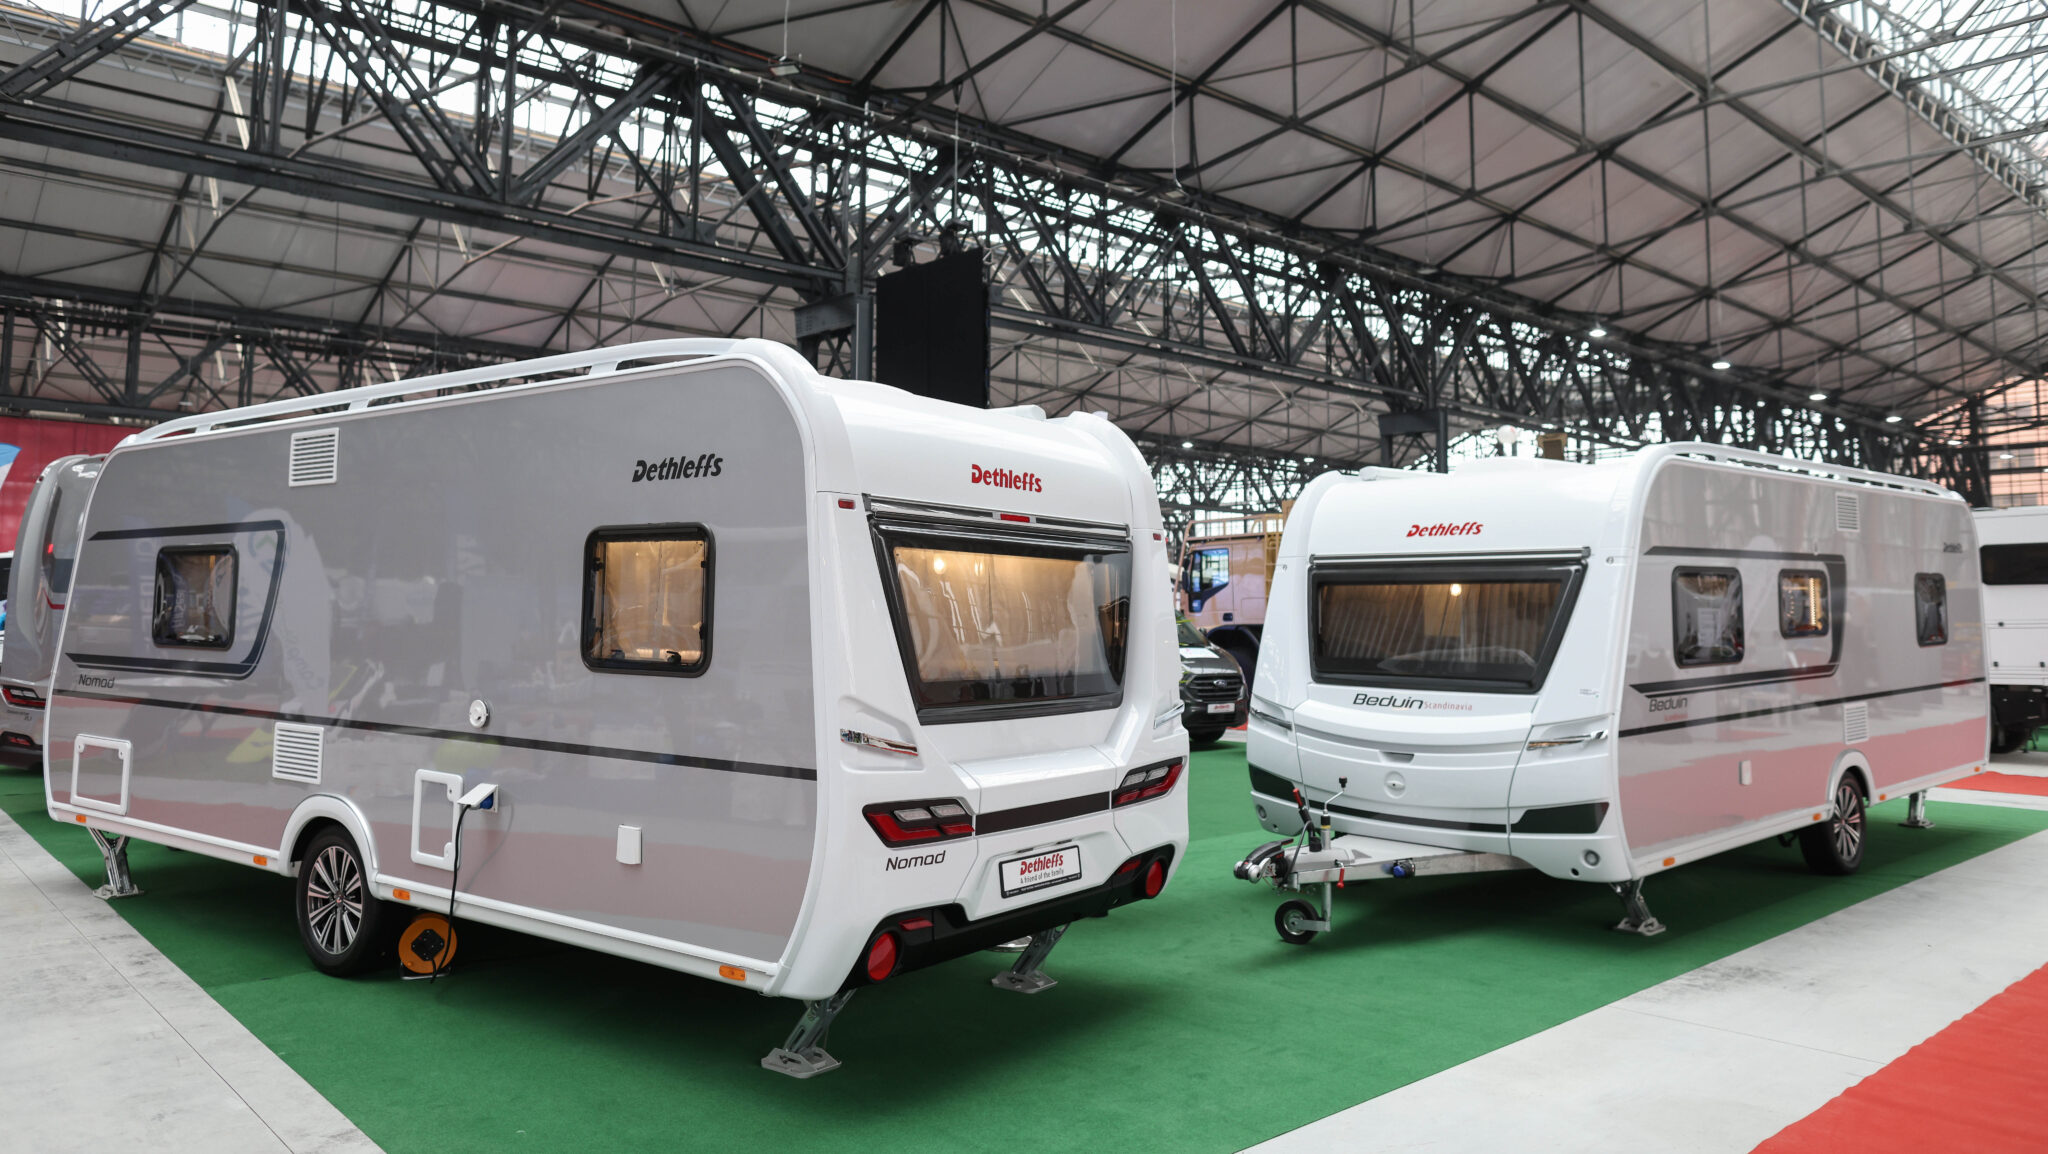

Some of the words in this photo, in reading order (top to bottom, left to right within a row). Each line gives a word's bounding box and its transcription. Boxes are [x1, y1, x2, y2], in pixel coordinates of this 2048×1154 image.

[632, 453, 724, 482] Dethleffs
[971, 463, 1043, 493] Dethleffs
[1405, 521, 1484, 538] Dethleffs
[78, 673, 115, 689] Nomad
[1352, 693, 1424, 709] Beduin
[1424, 701, 1473, 711] Scandinavia
[1649, 697, 1688, 713] Beduin
[885, 850, 946, 871] Nomad
[1020, 853, 1064, 876] Dethleffs
